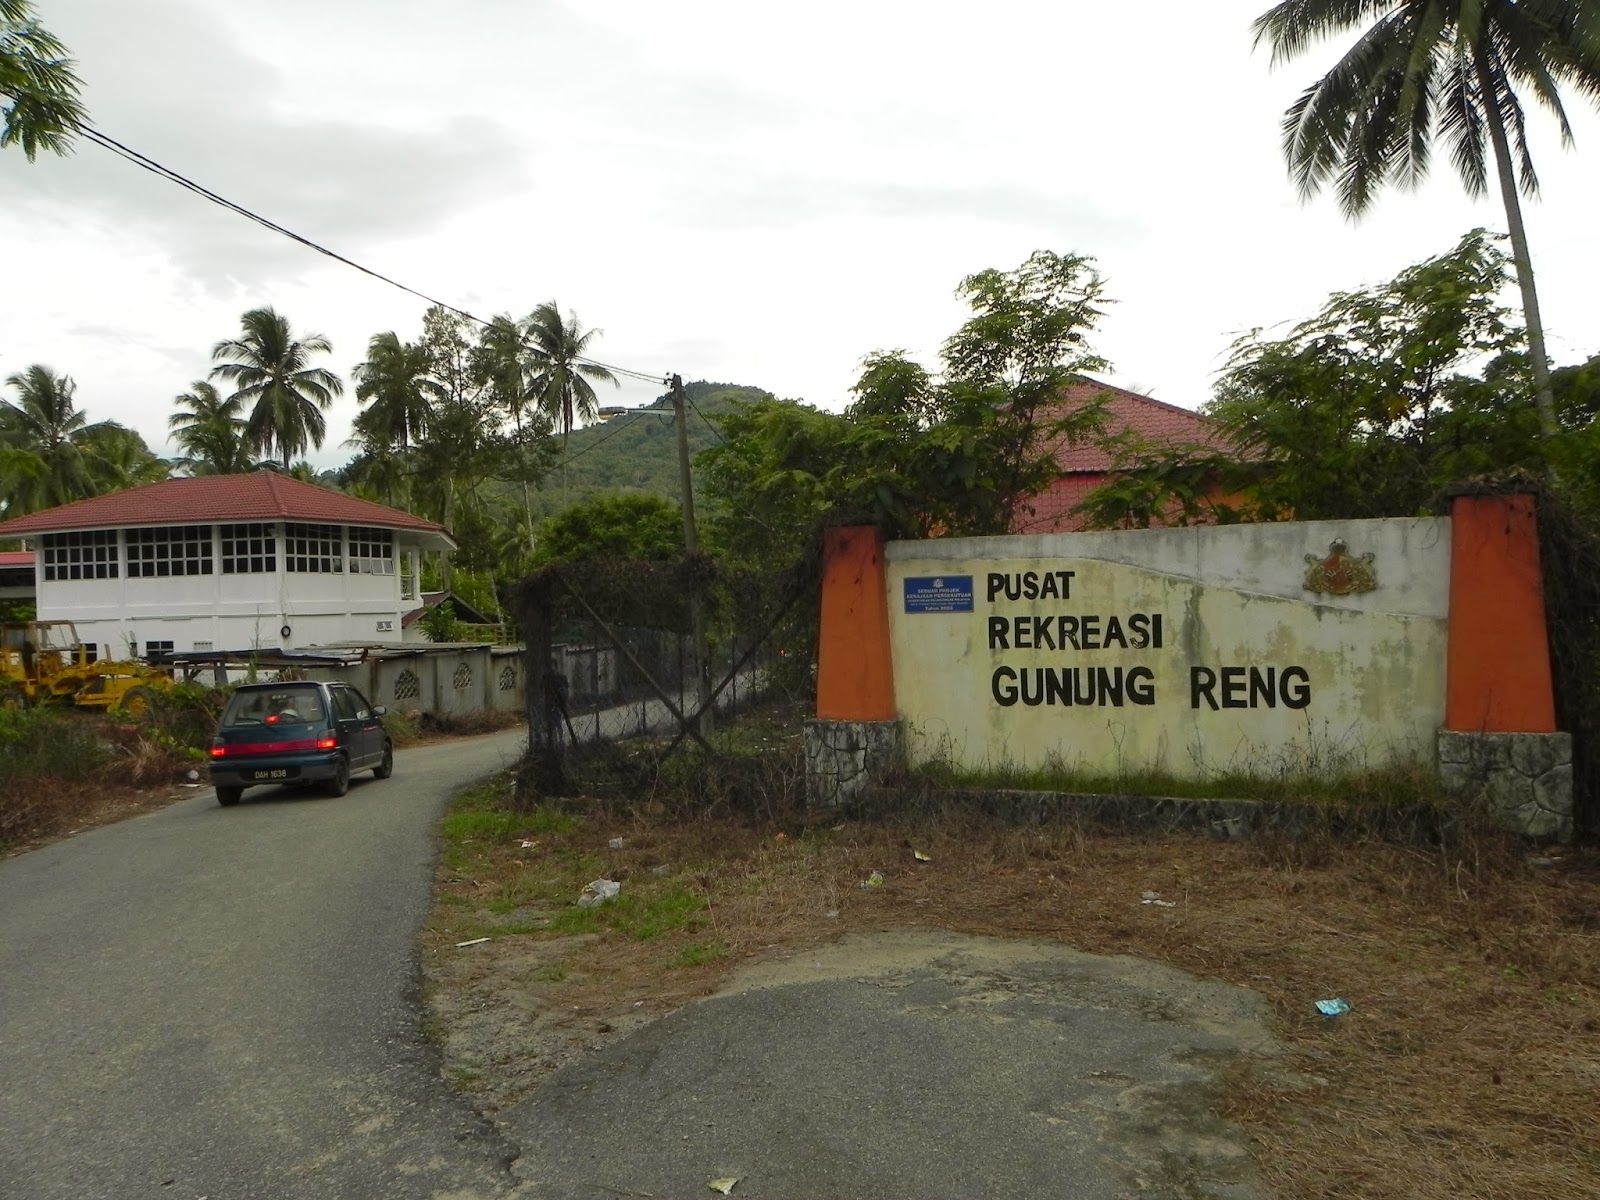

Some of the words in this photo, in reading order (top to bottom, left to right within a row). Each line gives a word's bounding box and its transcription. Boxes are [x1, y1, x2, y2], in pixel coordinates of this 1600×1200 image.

[987, 571, 1075, 602] PUSAT
[988, 613, 1163, 651] REKREASI
[991, 665, 1156, 707] GUNUNG
[1190, 665, 1312, 711] RENG
[271, 769, 287, 778] 1638
